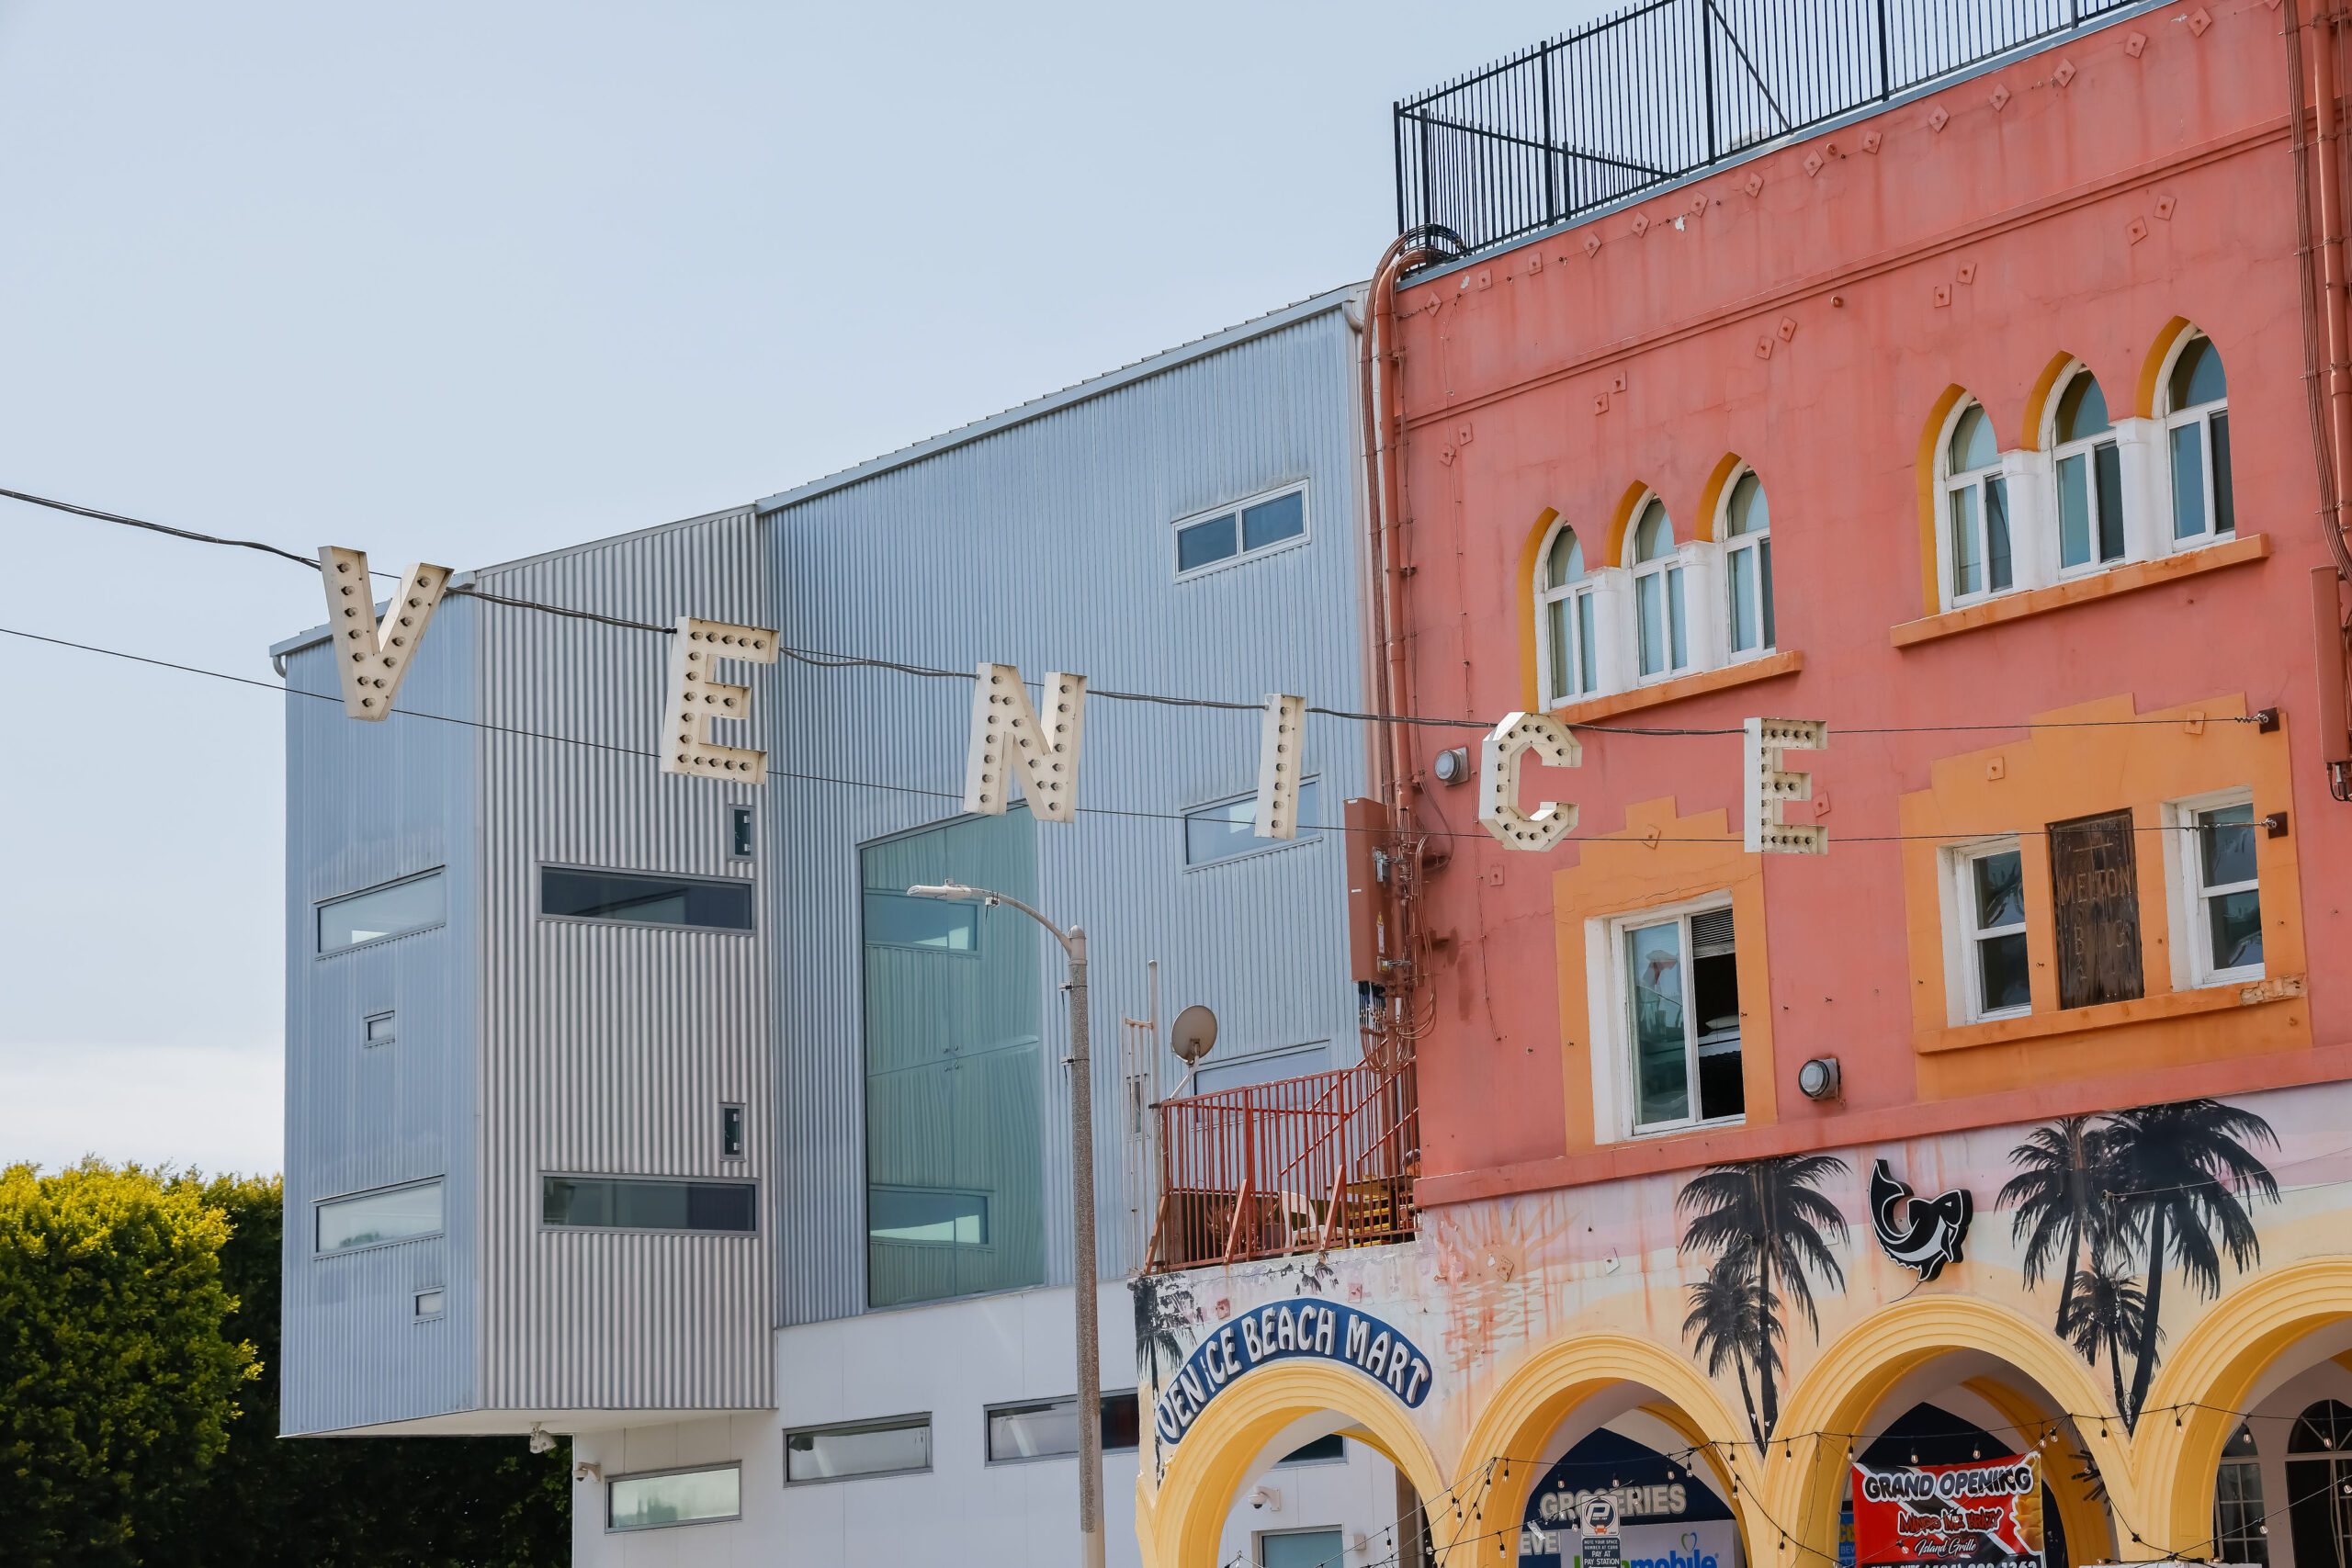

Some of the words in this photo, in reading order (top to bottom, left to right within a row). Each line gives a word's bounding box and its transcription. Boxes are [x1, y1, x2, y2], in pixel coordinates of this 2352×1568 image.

[319, 546, 1828, 854] VENICE
[1156, 1326, 1242, 1439] VENICE
[1241, 1304, 1336, 1363] BEACH
[1345, 1314, 1430, 1404] MART
[1864, 1473, 1936, 1501] GRAND
[1939, 1466, 2033, 1497] OPENING
[1539, 1483, 1687, 1522] GROERIES
[1520, 1530, 1561, 1555] EVE
[1914, 1539, 1948, 1558] Island
[1948, 1537, 1977, 1557] Grille
